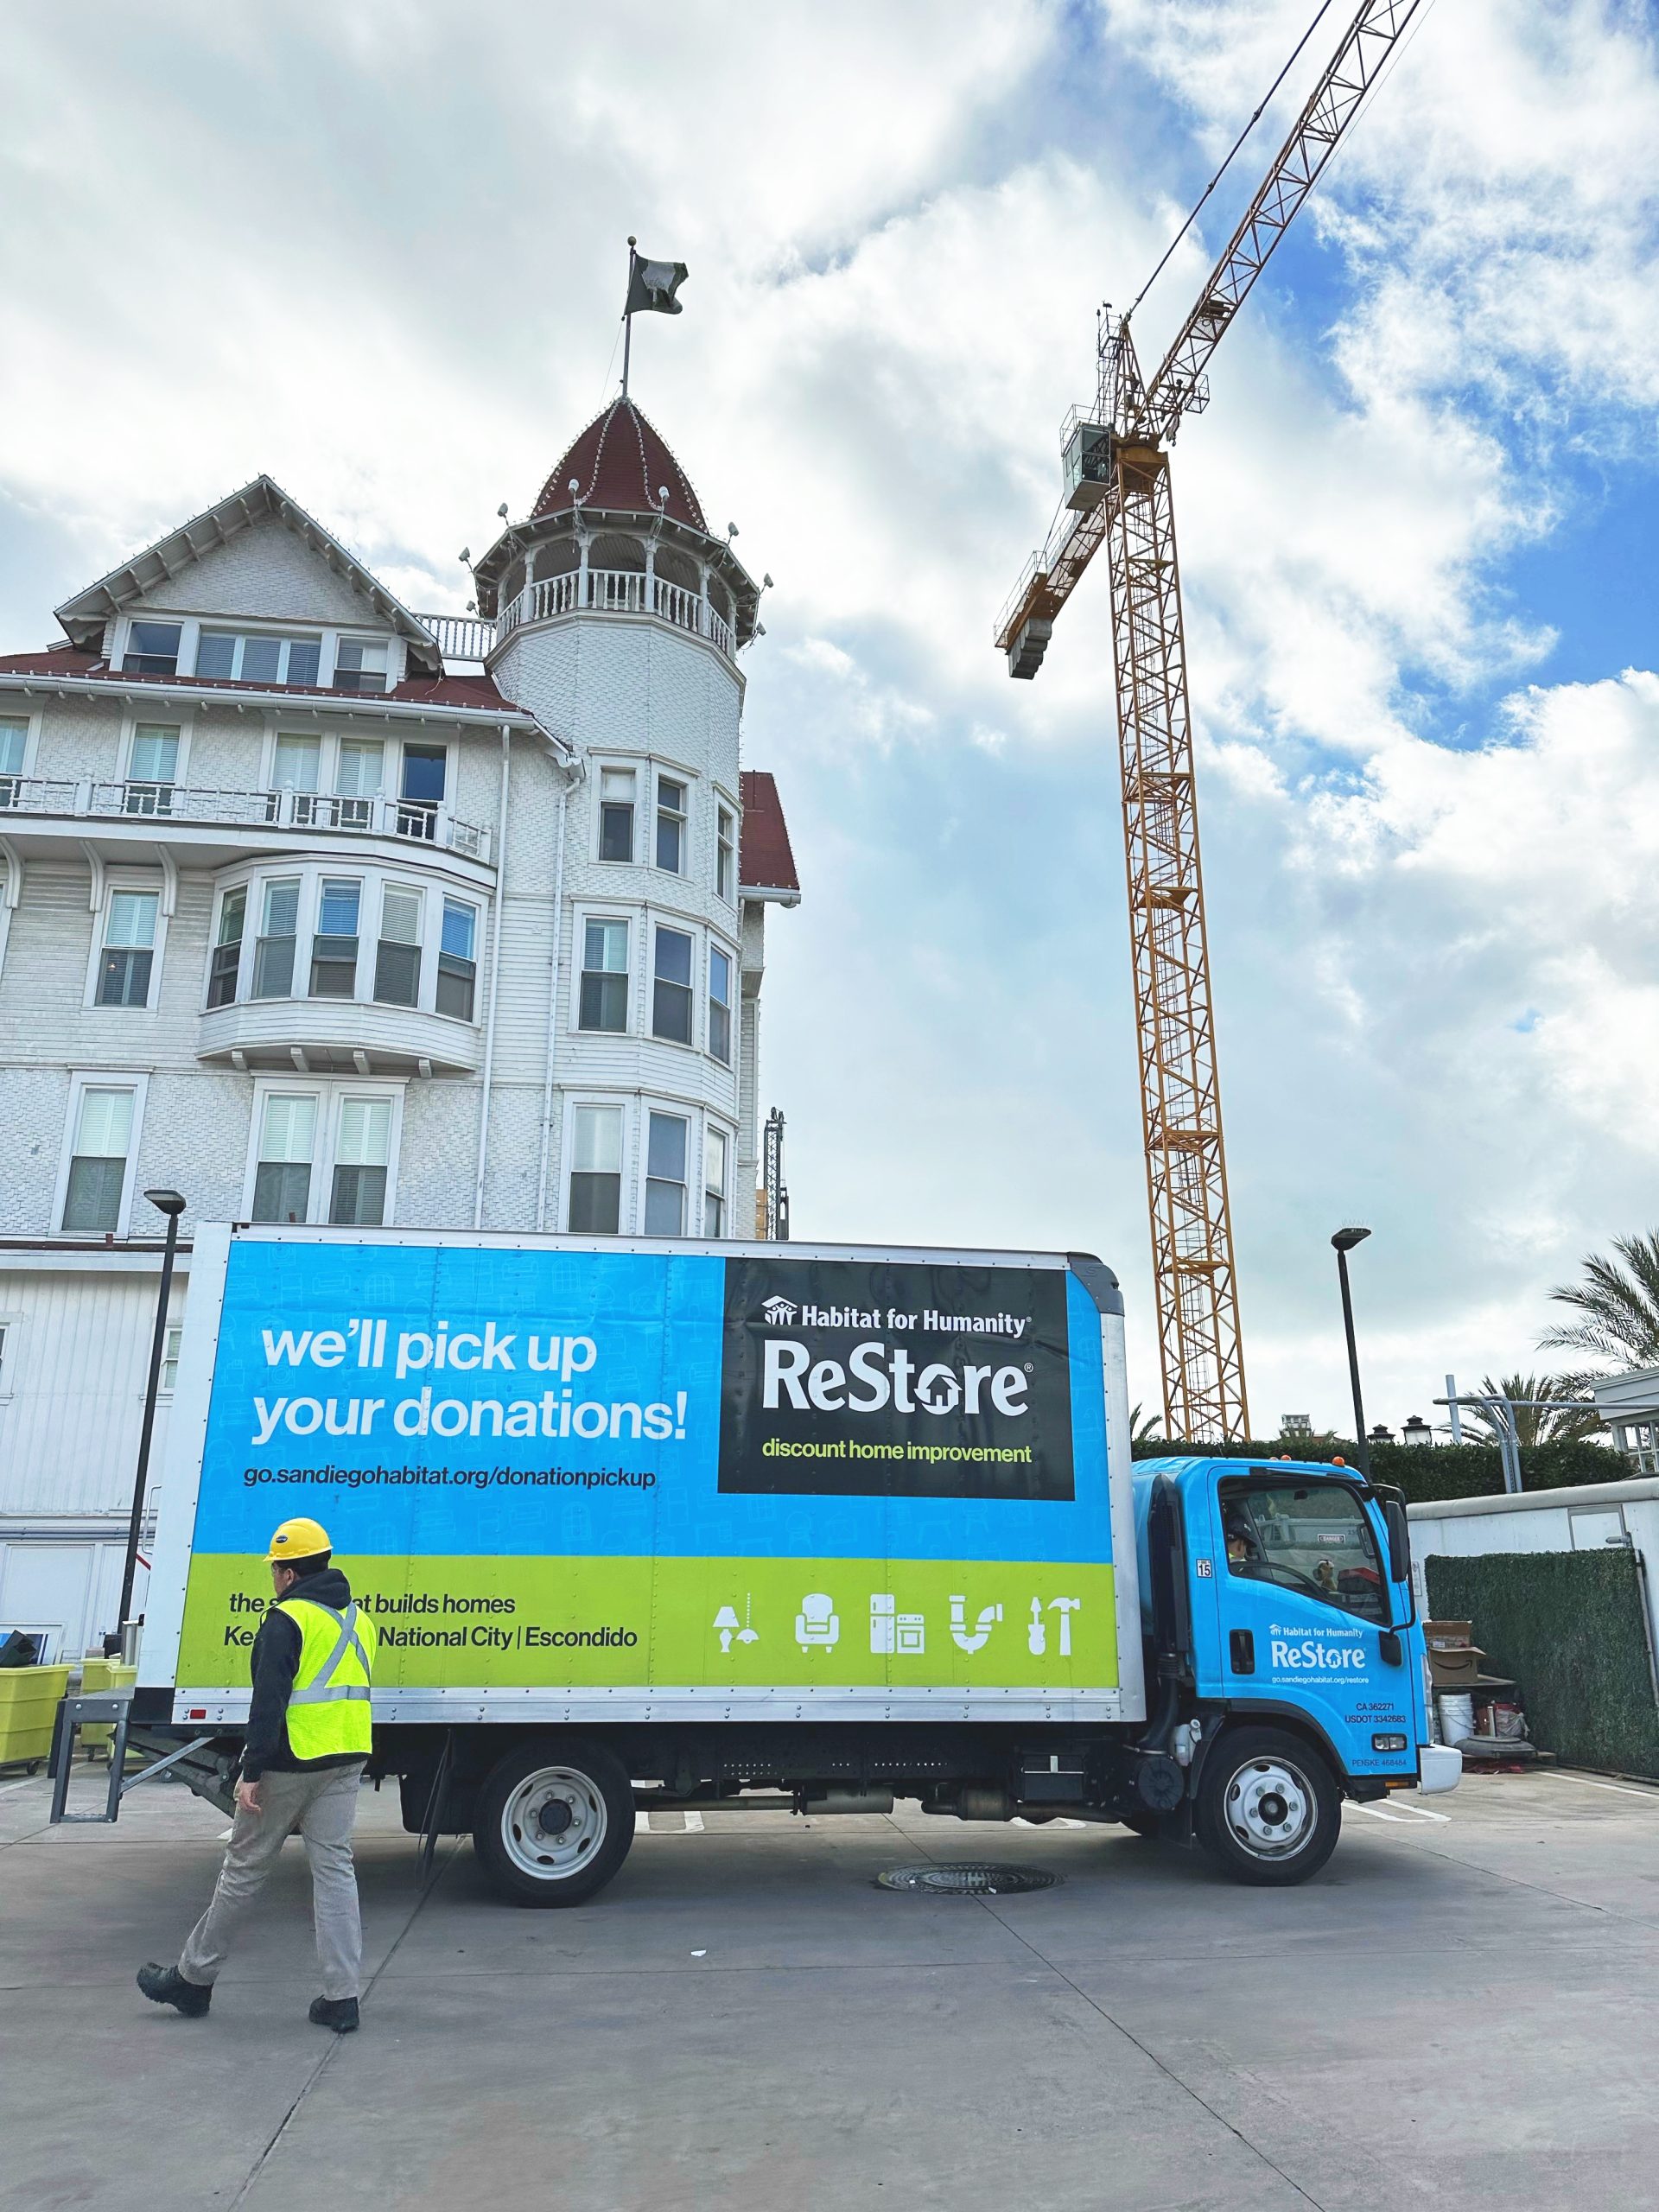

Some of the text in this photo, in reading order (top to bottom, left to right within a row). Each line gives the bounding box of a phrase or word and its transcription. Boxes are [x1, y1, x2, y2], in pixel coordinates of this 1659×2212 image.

[802, 1306, 881, 1329] Habitat
[887, 1308, 918, 1331] for
[396, 1321, 516, 1379] pick
[528, 1336, 597, 1381] up
[762, 1339, 1030, 1416] ReStore
[251, 1386, 687, 1445] your donations!
[762, 1438, 1032, 1464] discount home improvement
[244, 1465, 656, 1490] go.sandiegohabitat.org/donationpickup
[1198, 1564, 1211, 1576] 15
[229, 1592, 264, 1613] the
[374, 1593, 439, 1614] builds
[442, 1594, 516, 1614] homes
[378, 1626, 638, 1651] National City Escondido
[1283, 1627, 1363, 1638] Habitat for Humanity
[1271, 1641, 1366, 1669] ReStore
[1272, 1676, 1370, 1685] go.sandiegohabitat.org/restore
[1344, 1715, 1372, 1724] USDOT
